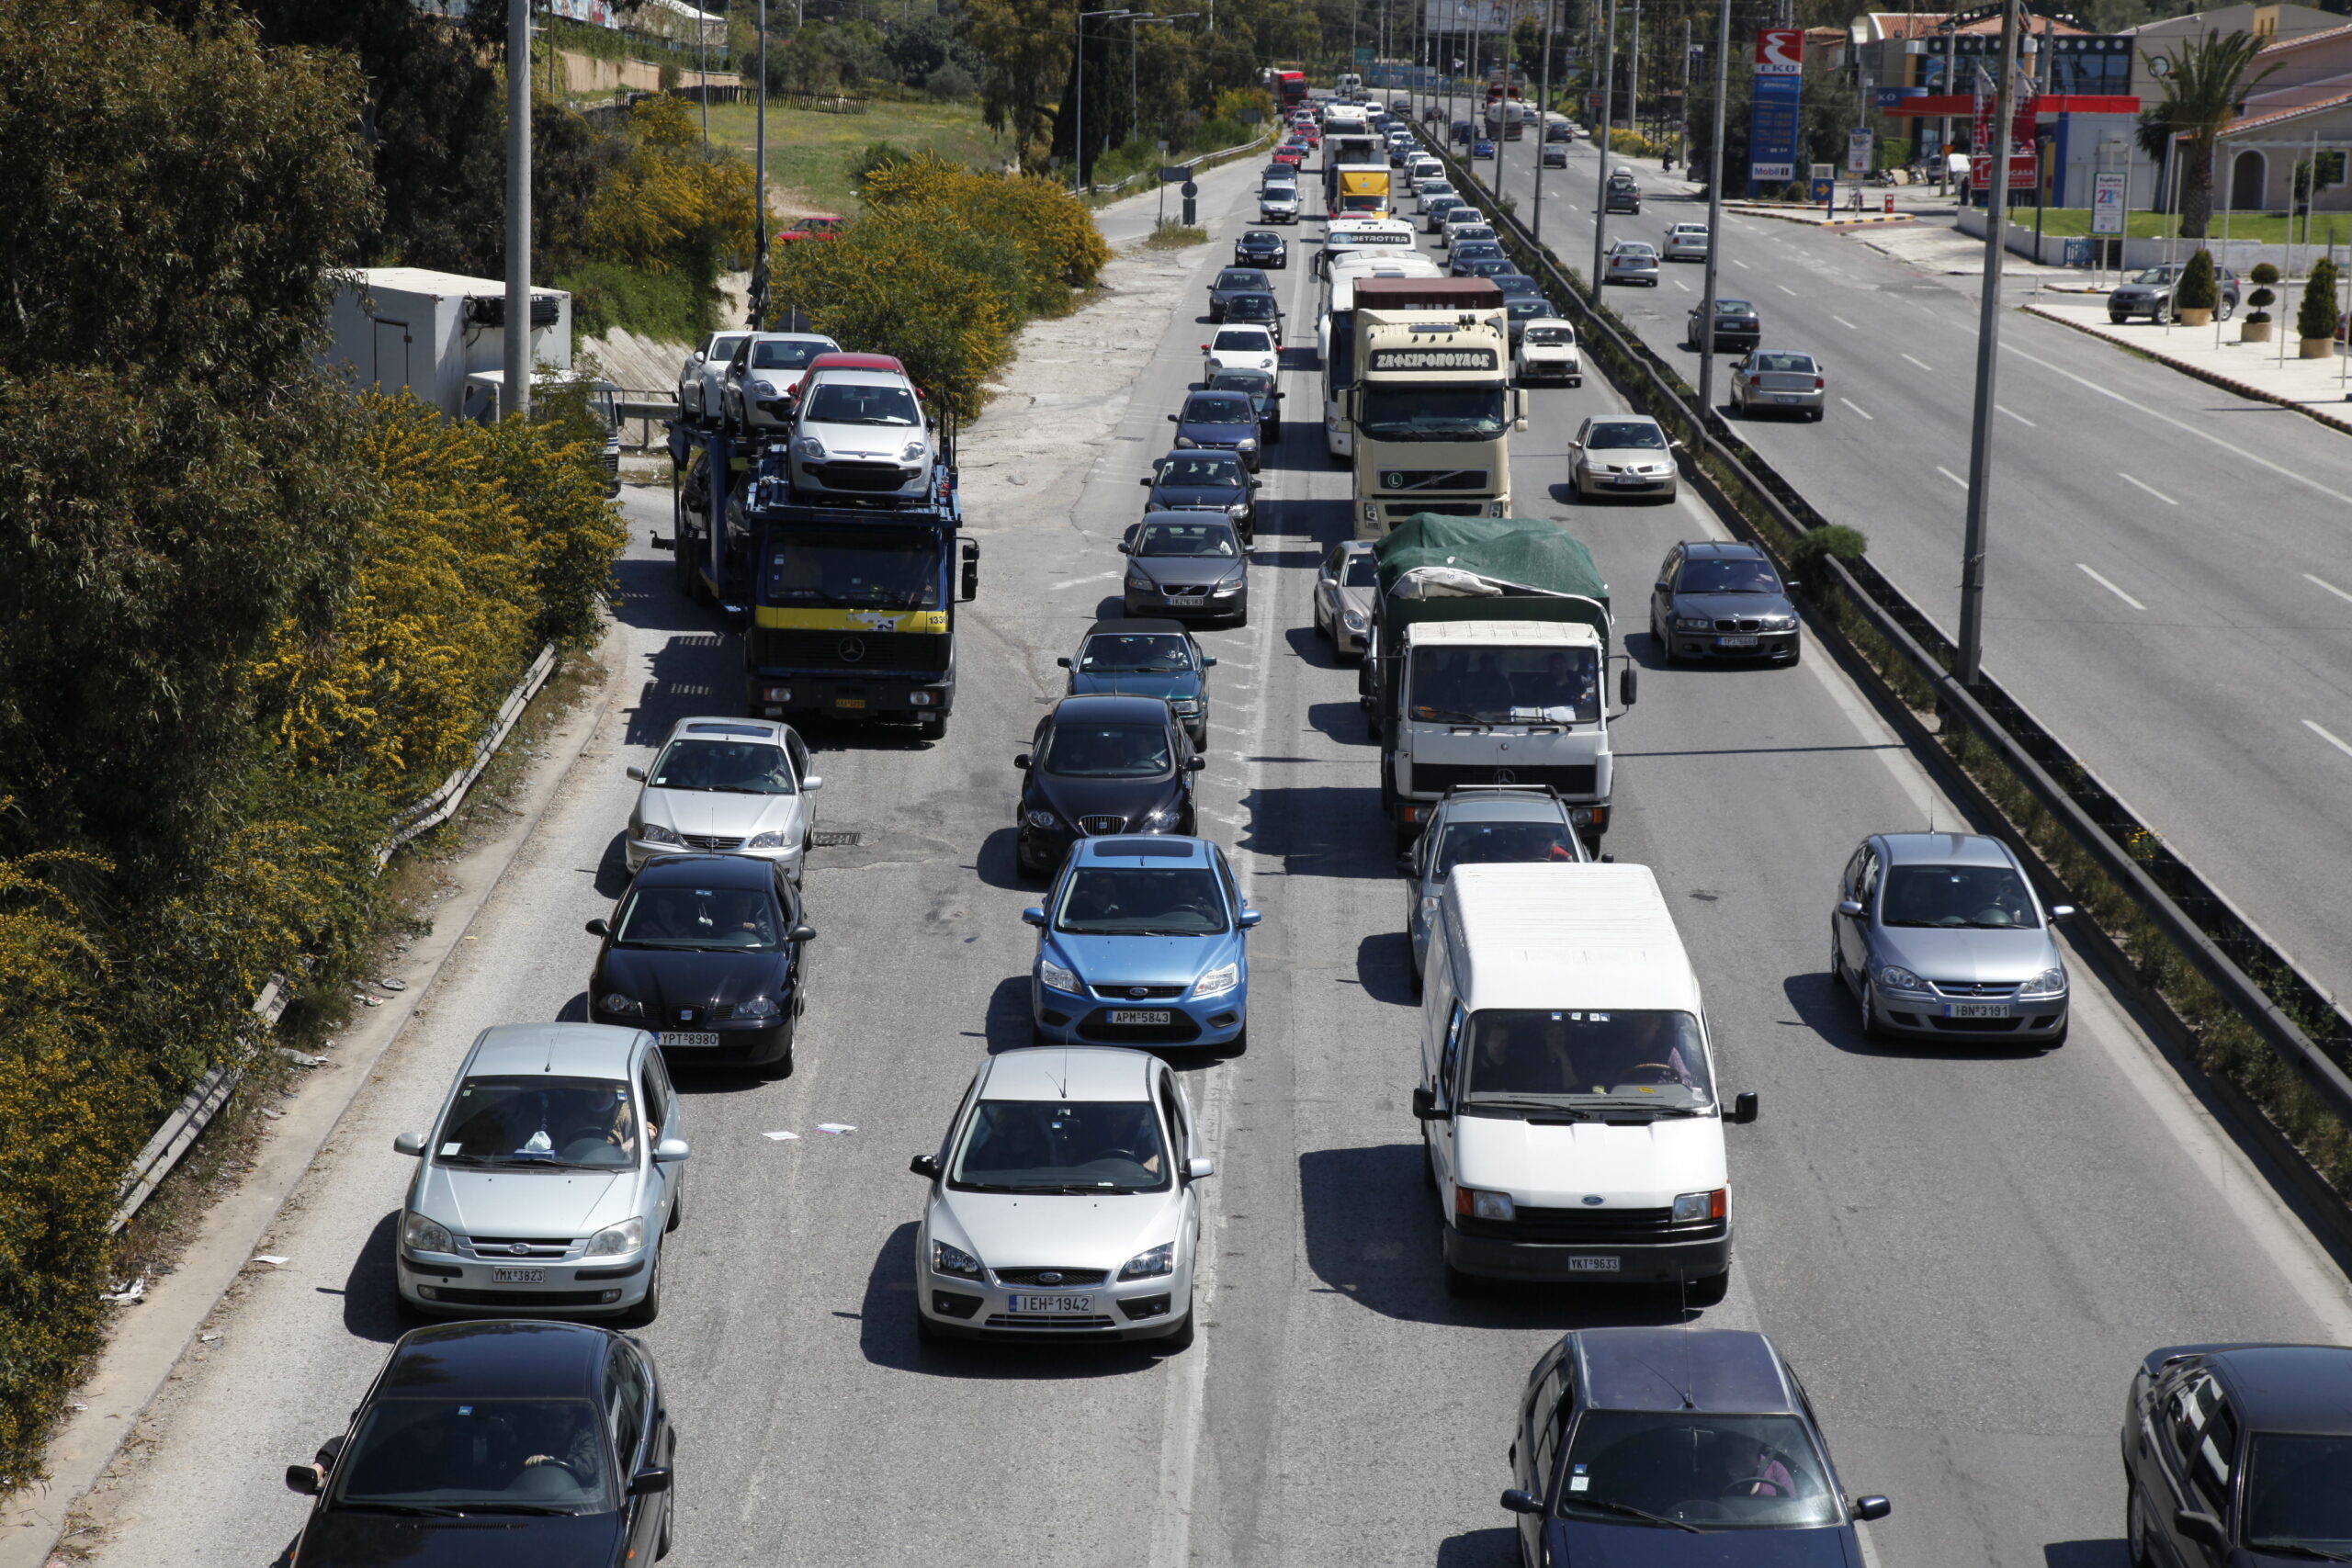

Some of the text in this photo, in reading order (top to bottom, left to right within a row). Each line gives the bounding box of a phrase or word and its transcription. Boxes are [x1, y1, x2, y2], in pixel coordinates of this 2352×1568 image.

[1755, 167, 1780, 175] Mobil
[1115, 1012, 1170, 1023] APM-5843
[661, 1033, 717, 1045] YPT-8980
[1023, 1297, 1090, 1311] IEH-1942
